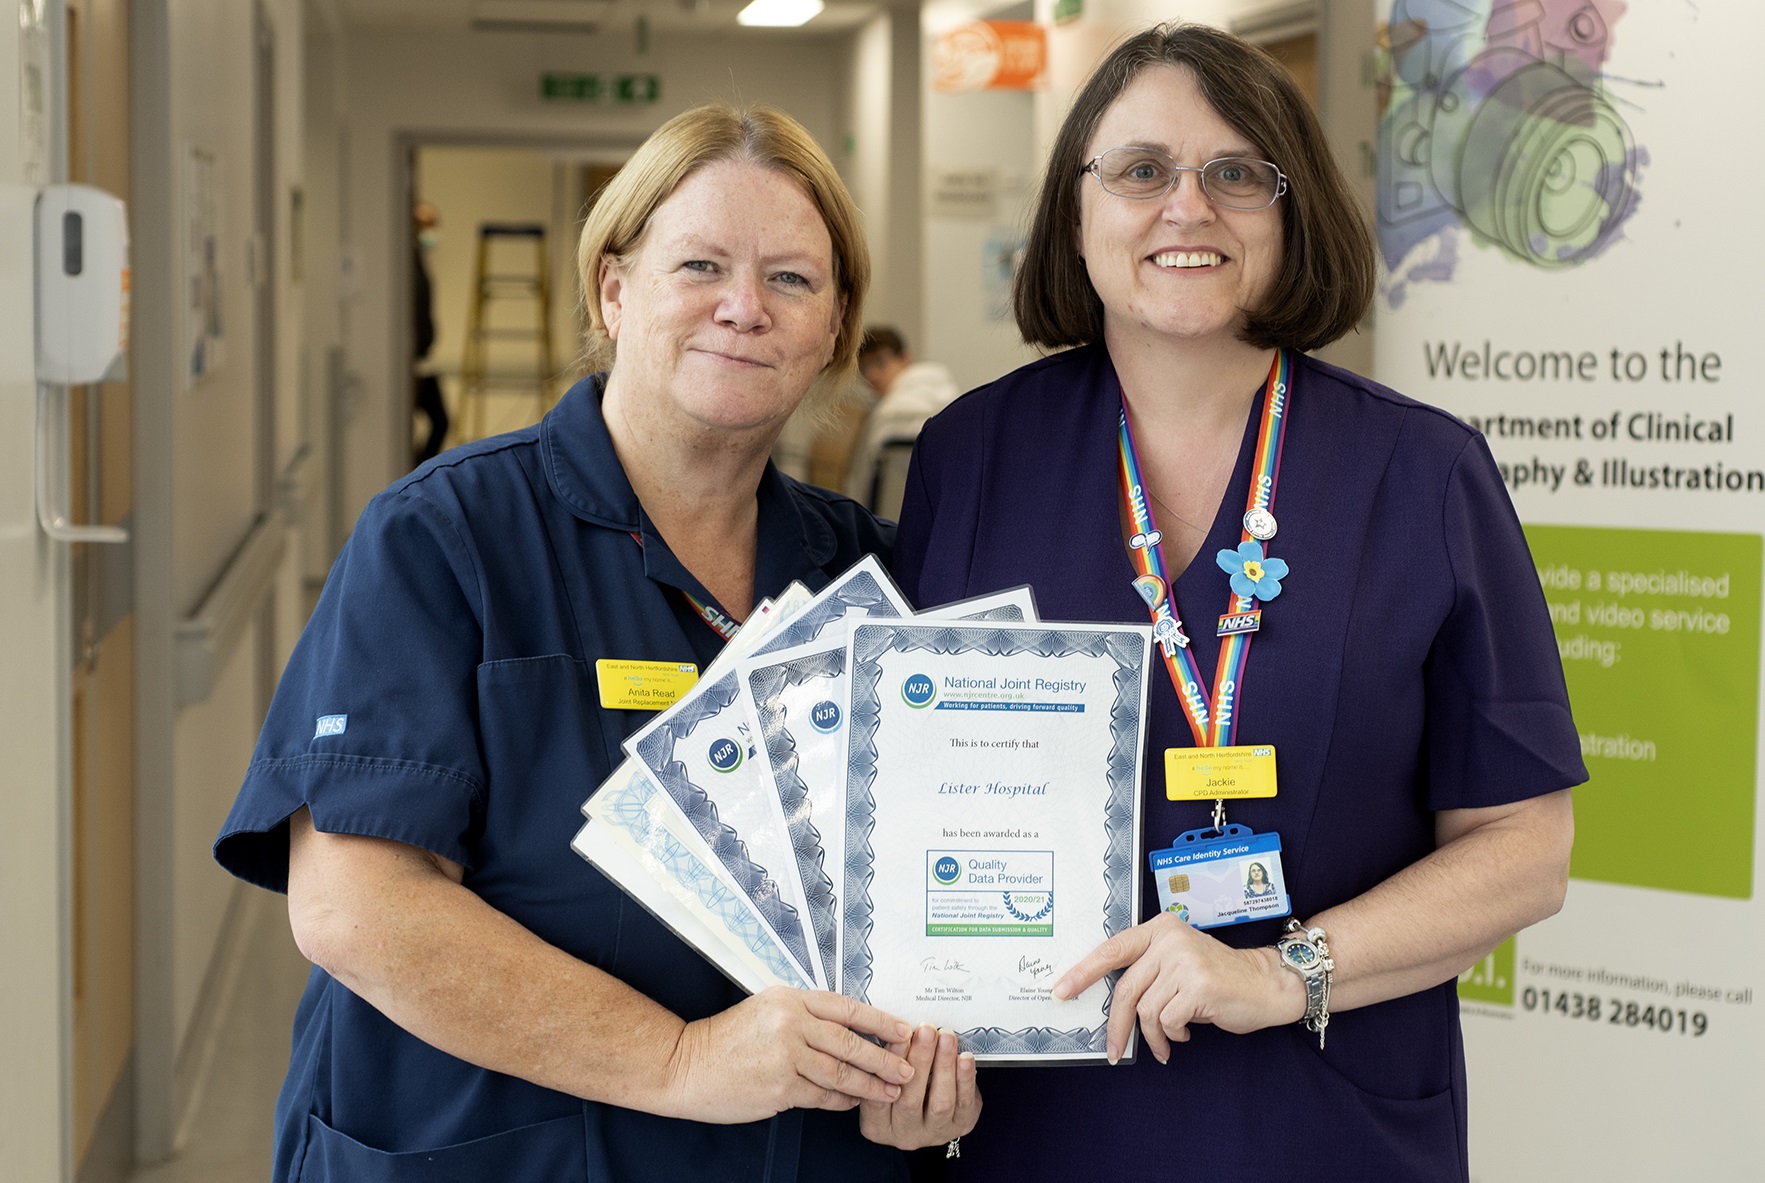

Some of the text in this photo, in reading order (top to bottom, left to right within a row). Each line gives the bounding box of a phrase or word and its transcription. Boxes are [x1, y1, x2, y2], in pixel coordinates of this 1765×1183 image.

[1424, 340, 1722, 383] Welcome to the
[1269, 380, 1287, 418] NHS
[1464, 410, 1734, 443] artment of Clinical
[1574, 458, 1595, 486] &
[1602, 458, 1765, 491] Illustration
[1127, 484, 1149, 525] NHS
[1539, 564, 1730, 599] vide a specialised
[1222, 614, 1255, 630] NHS
[1586, 602, 1645, 629] video
[1650, 607, 1731, 635] service
[628, 688, 676, 698] Anita Read
[908, 682, 930, 694] NJR
[944, 676, 1087, 694] National Joint Registry
[632, 699, 670, 707] Replacement
[944, 692, 1025, 700] www.njrcentre.org.uk
[1180, 681, 1210, 725] NHS
[1215, 680, 1236, 726] NHS
[815, 707, 836, 721] NJR
[1010, 704, 1032, 712] driving
[316, 717, 345, 735] NHS
[713, 743, 734, 763] NJR
[950, 738, 1039, 750] This is to certify that
[938, 782, 1050, 800] Lister Hospital
[1206, 778, 1236, 787] Jackie
[942, 828, 958, 838] has
[960, 828, 981, 838] been
[983, 828, 1021, 838] awarded
[1156, 844, 1250, 866] NHS Care Identity Service
[938, 864, 956, 874] NJR
[968, 859, 1008, 872] Quality
[968, 873, 1044, 884] Data Provider
[1217, 903, 1280, 918] Jacqueline Thompson
[1522, 957, 1753, 1004] For more information, please call
[1522, 986, 1601, 1020] 01438
[1609, 999, 1710, 1038] 284019
